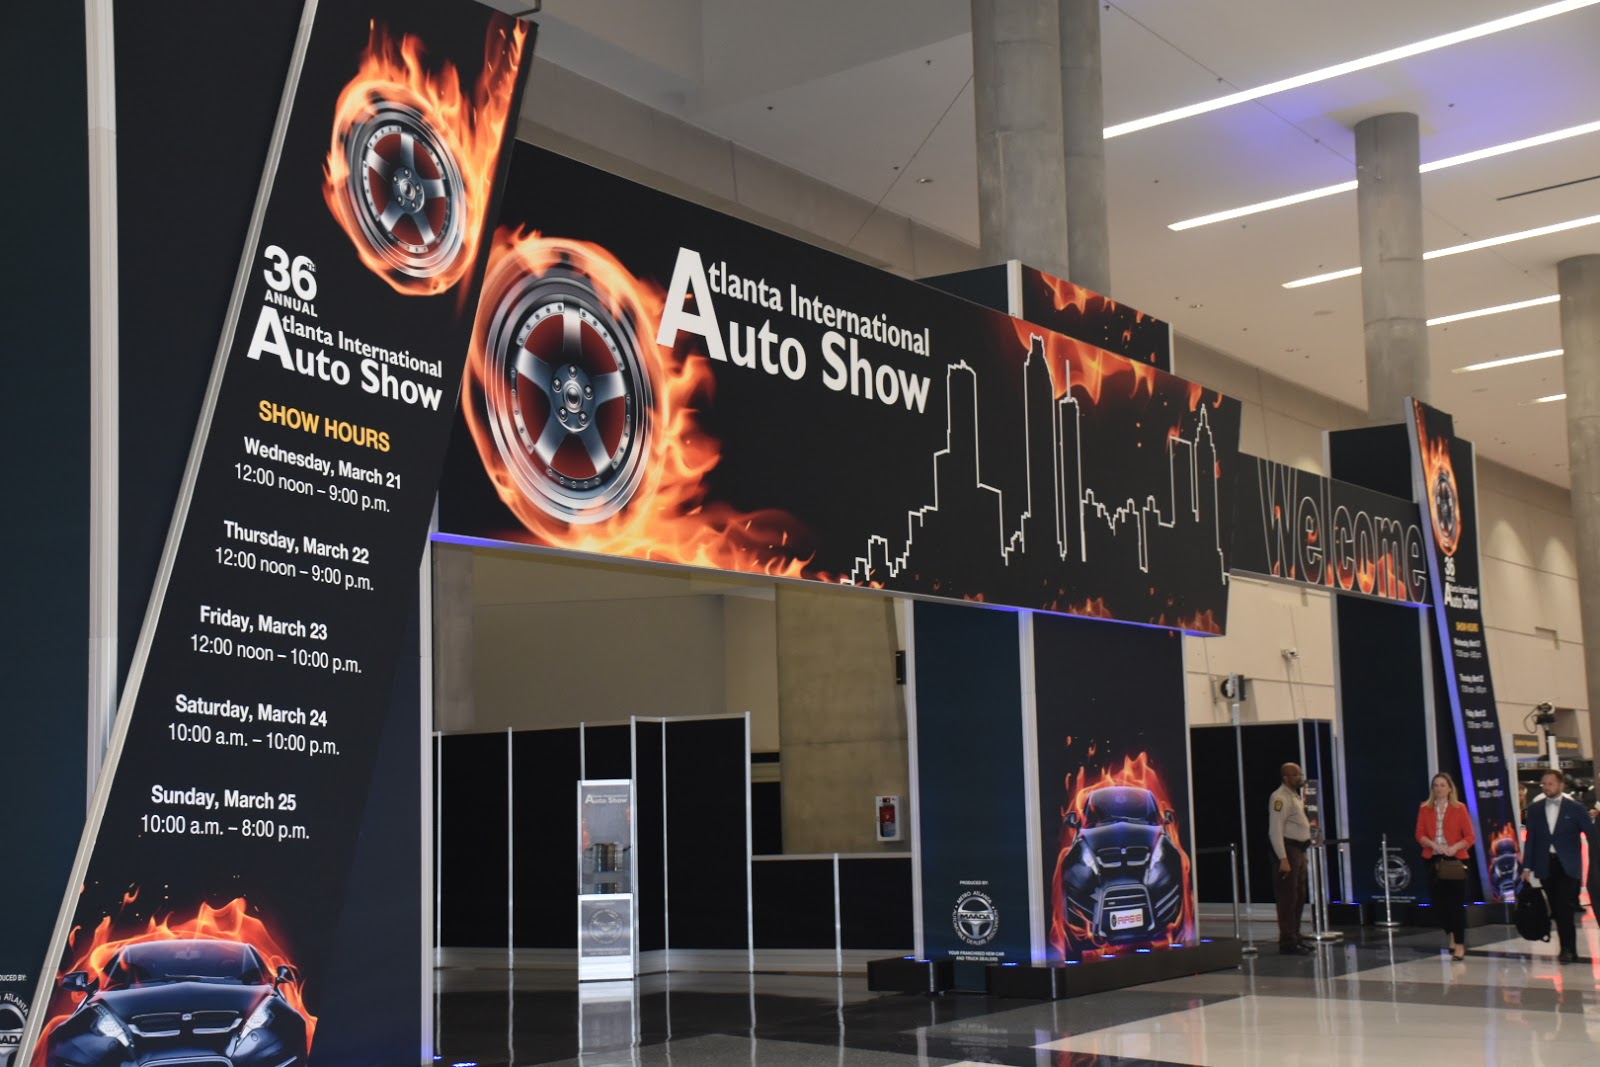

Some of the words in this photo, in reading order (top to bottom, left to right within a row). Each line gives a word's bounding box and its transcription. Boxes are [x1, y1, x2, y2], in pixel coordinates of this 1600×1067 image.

[264, 289, 318, 317] ANNUAL
[790, 283, 930, 357] International
[656, 247, 807, 381] Auto
[821, 330, 931, 414] Show
[247, 304, 351, 386] Auto
[360, 358, 443, 411] Show
[338, 330, 443, 378] International
[258, 400, 319, 435] SHOW
[325, 417, 391, 452] HOURS
[243, 436, 335, 477] Wednesday,
[339, 460, 382, 487] March
[385, 472, 401, 490] 21
[234, 463, 275, 487] 12:00
[278, 475, 314, 496] noon
[329, 485, 359, 507] 9:00
[361, 497, 391, 513] p.m.
[223, 520, 300, 554] Thursday,
[303, 536, 349, 560] March
[352, 547, 370, 565] 22
[1257, 457, 1427, 605] Welcome
[215, 547, 256, 570] 12:00
[260, 558, 297, 578] noon
[311, 567, 342, 585] 9:00
[345, 574, 374, 591] p.m.
[200, 605, 254, 633] Friday,
[258, 614, 306, 638] March
[310, 622, 328, 640] 23
[190, 634, 233, 656] 12:00
[237, 643, 274, 662] noon
[290, 649, 329, 669] 10:00
[333, 657, 362, 674] p.m.
[175, 694, 254, 723] Saturday,
[257, 703, 306, 725] March
[310, 710, 328, 727] 24
[168, 723, 211, 744] 10:00
[215, 730, 248, 747] a.m.
[266, 732, 306, 752] 10:00
[309, 739, 340, 757] p.m.
[151, 784, 220, 810] Sunday,
[224, 790, 274, 810] March
[278, 793, 297, 811] 25
[141, 815, 186, 835] 10:00
[190, 819, 224, 836] a.m.
[242, 820, 275, 839] 8:00
[278, 825, 310, 842] p.m.
